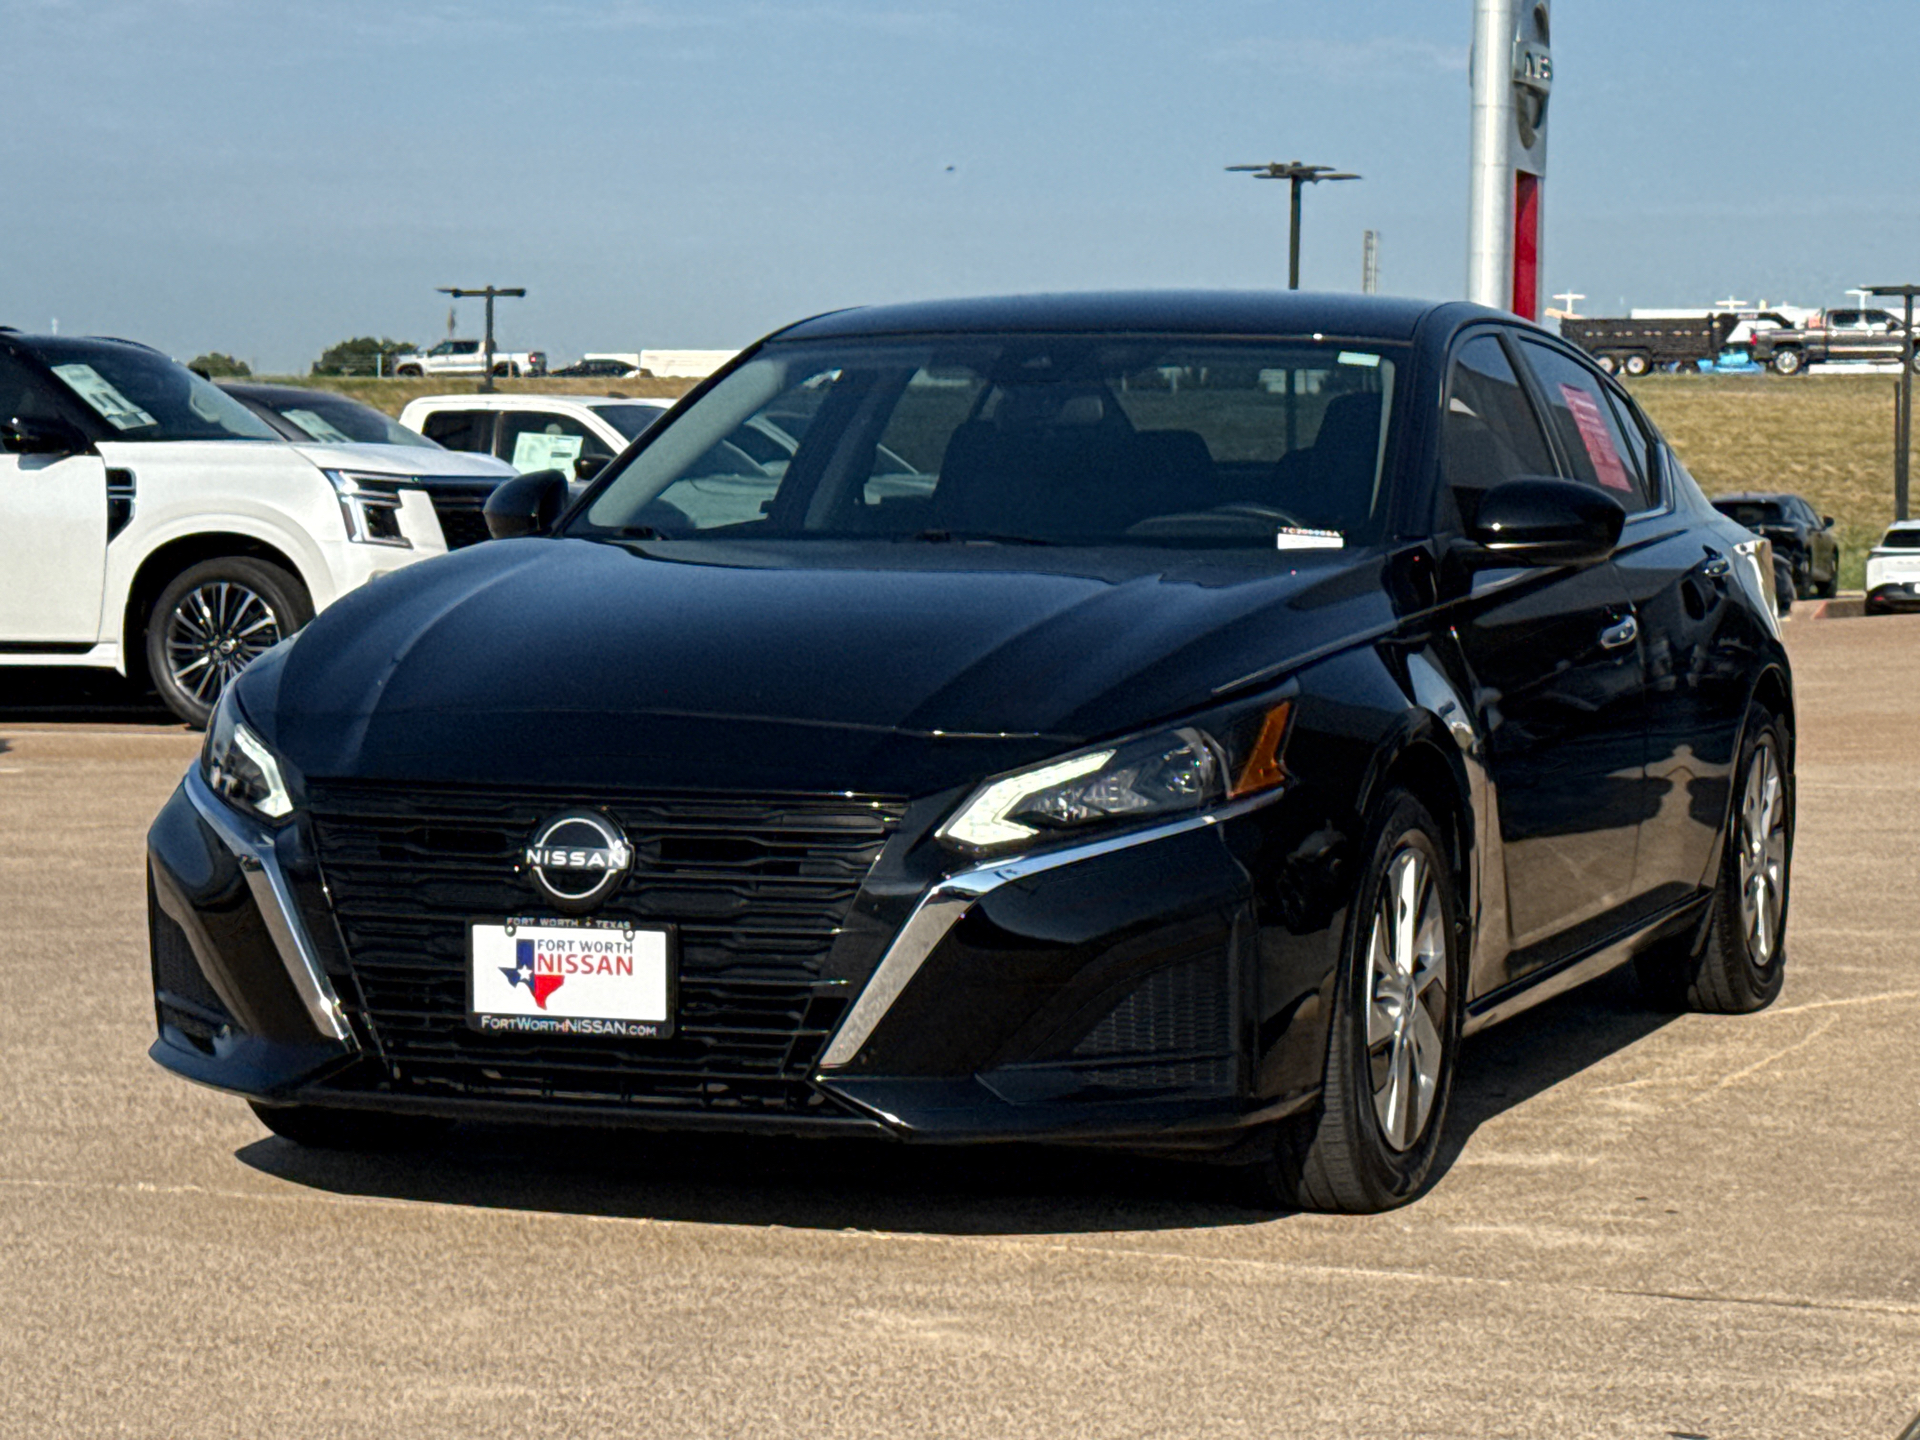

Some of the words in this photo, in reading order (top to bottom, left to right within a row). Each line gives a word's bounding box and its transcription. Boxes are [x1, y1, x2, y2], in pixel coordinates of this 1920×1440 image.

[526, 848, 626, 867] NISSAN
[506, 917, 535, 926] FORT
[540, 918, 579, 927] WORTH
[596, 920, 631, 930] TEXAS
[537, 938, 576, 952] FORT
[579, 940, 633, 955] WORTH
[537, 953, 633, 976] NISSAN
